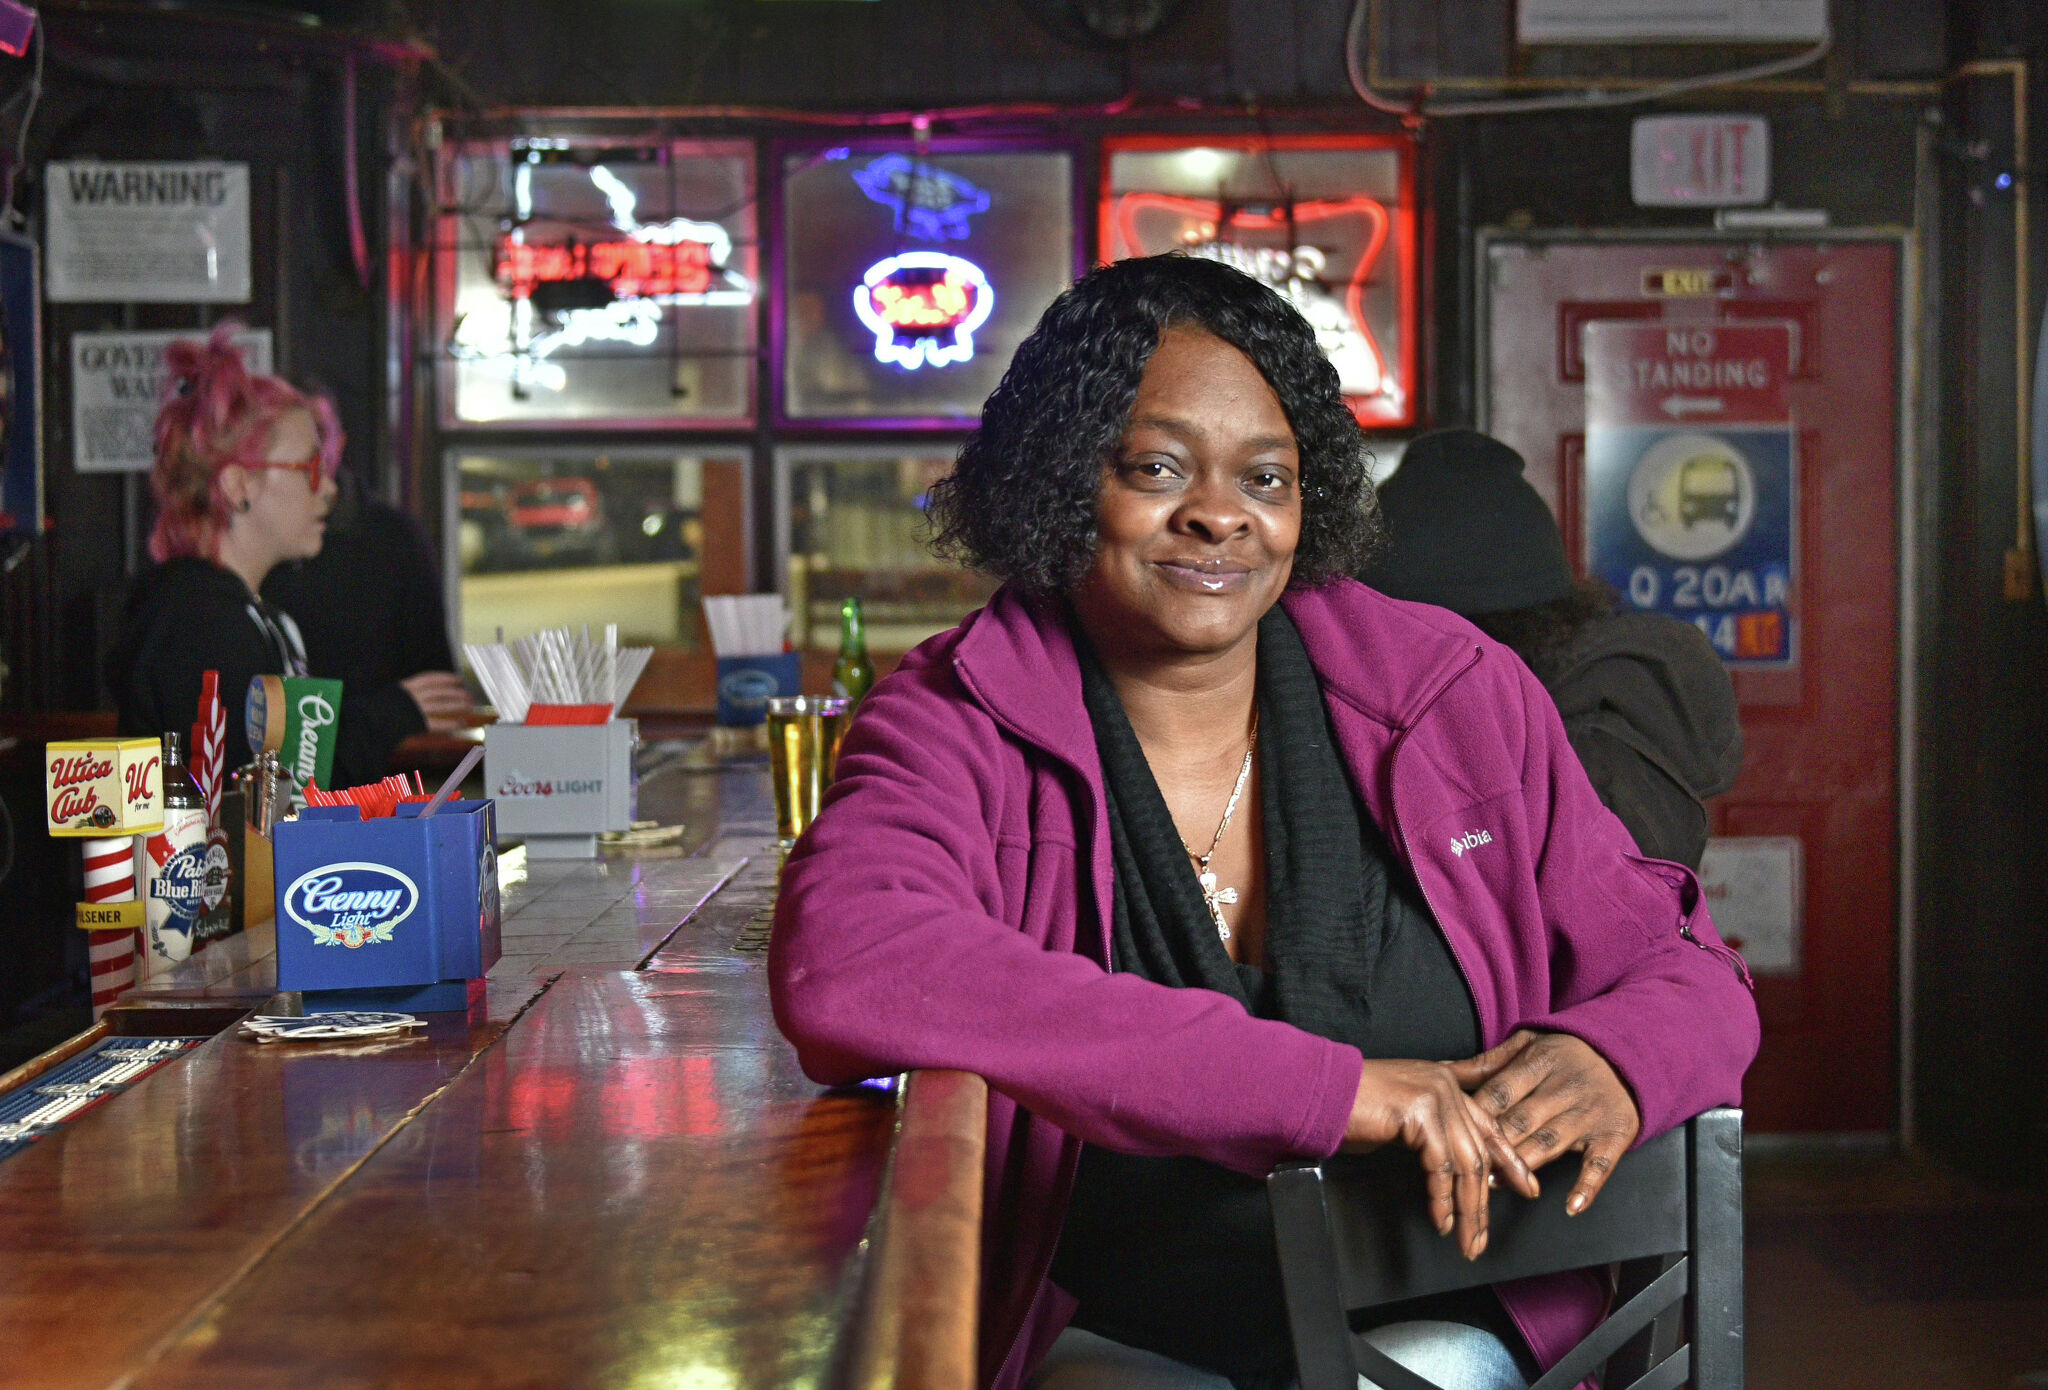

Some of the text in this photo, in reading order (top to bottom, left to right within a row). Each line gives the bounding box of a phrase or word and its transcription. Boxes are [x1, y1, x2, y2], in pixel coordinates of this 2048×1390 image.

[1659, 124, 1749, 195] EXIT
[68, 169, 227, 206] WARNING
[1667, 331, 1715, 357] NO
[1612, 359, 1768, 388] STANDING
[297, 693, 334, 783] Cream
[51, 751, 114, 789] Utica
[125, 756, 159, 804] UC
[499, 775, 602, 796] Coors LIGHT
[51, 786, 97, 824] Club
[176, 854, 204, 879] Pab
[154, 878, 190, 900] Blue
[301, 875, 402, 919] Genny
[330, 911, 371, 930] Light
